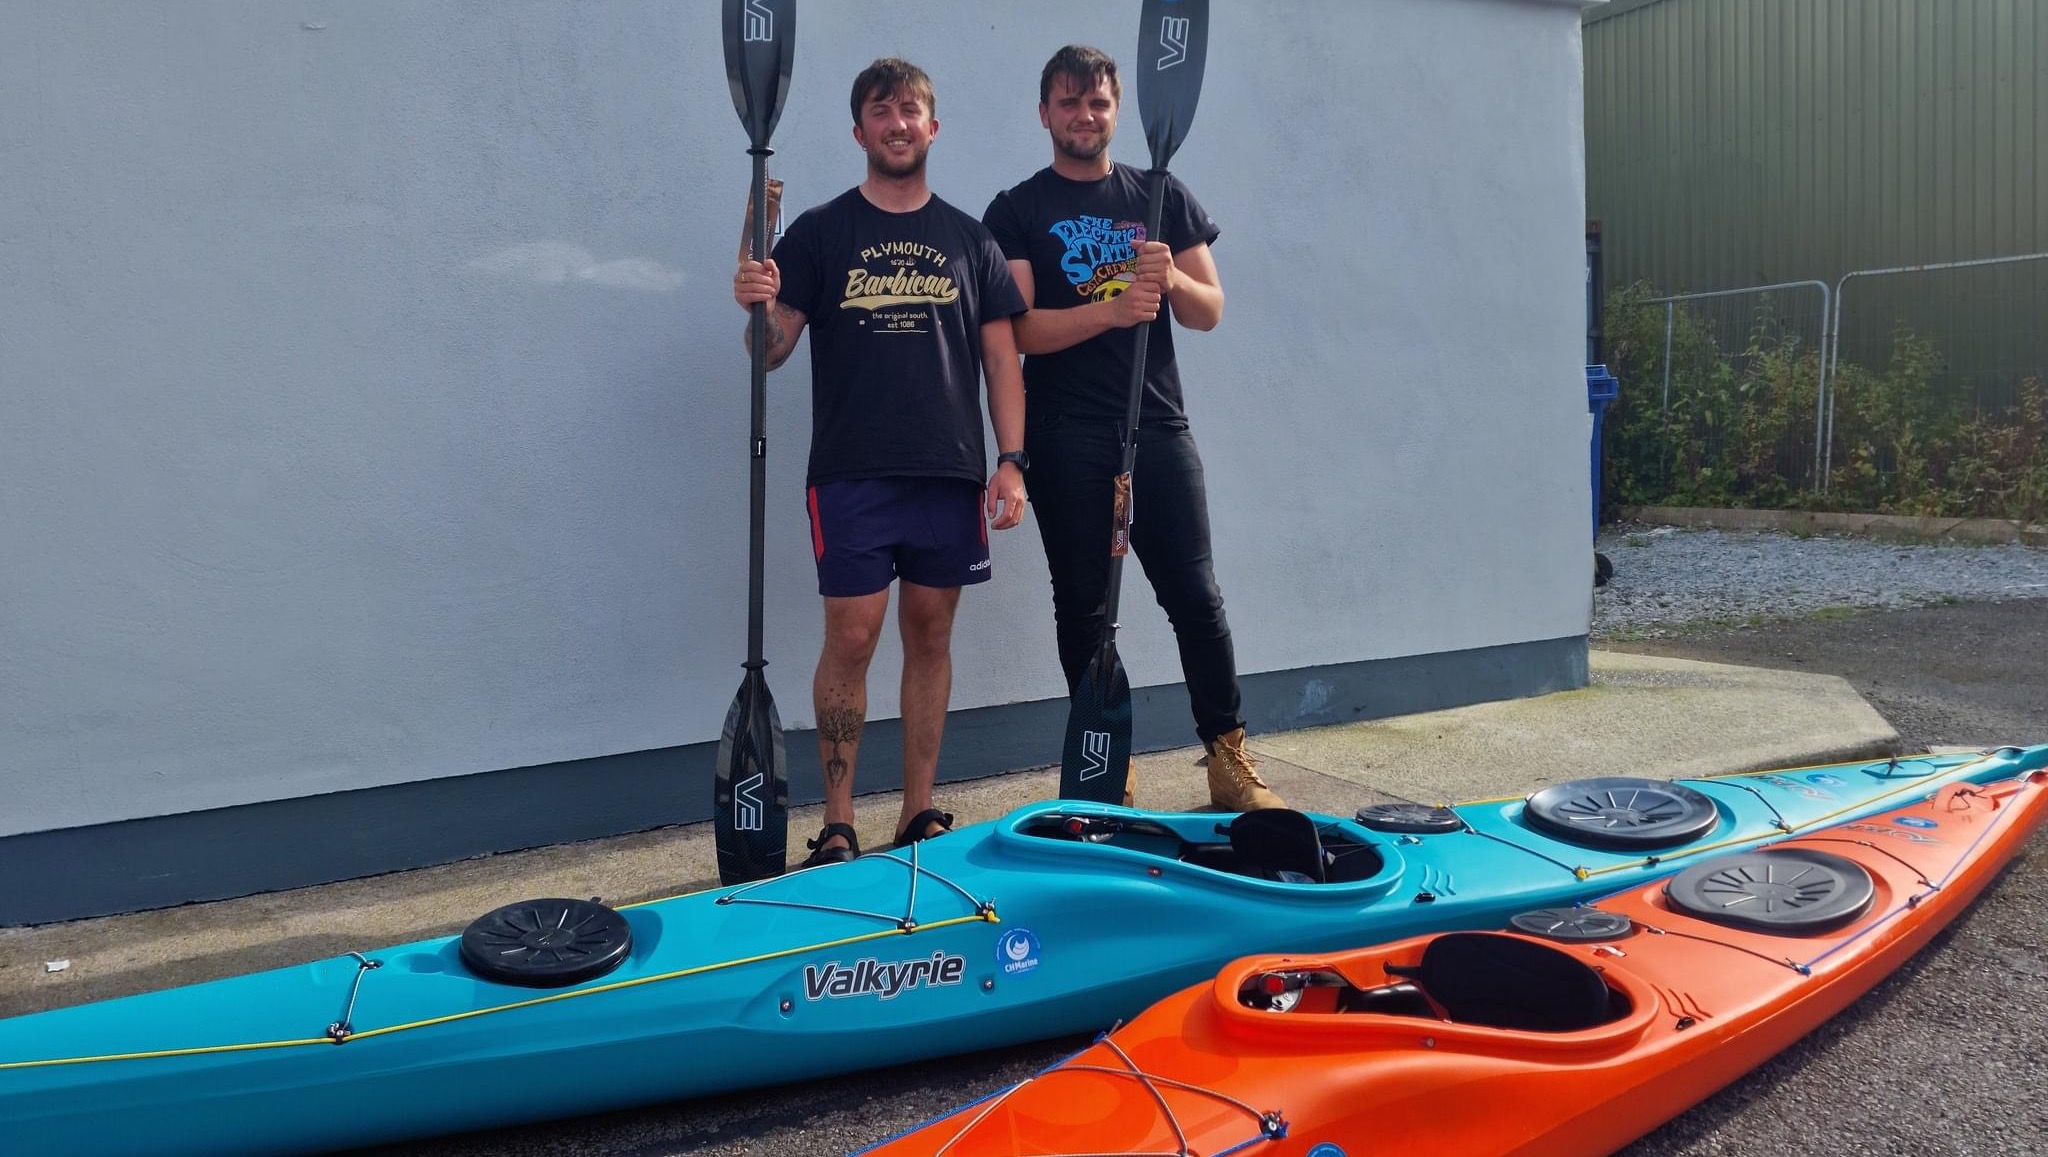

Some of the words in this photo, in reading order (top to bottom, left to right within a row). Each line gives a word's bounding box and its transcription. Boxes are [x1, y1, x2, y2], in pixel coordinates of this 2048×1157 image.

[1157, 16, 1189, 70] VE
[1080, 215, 1113, 230] THE
[860, 241, 947, 267] PLYMOUTH
[1061, 237, 1135, 285] STATE
[845, 267, 957, 299] Barbican
[884, 312, 908, 321] original
[1080, 730, 1110, 781] VE
[735, 772, 763, 831] VE
[804, 951, 966, 1001] Valkyrie
